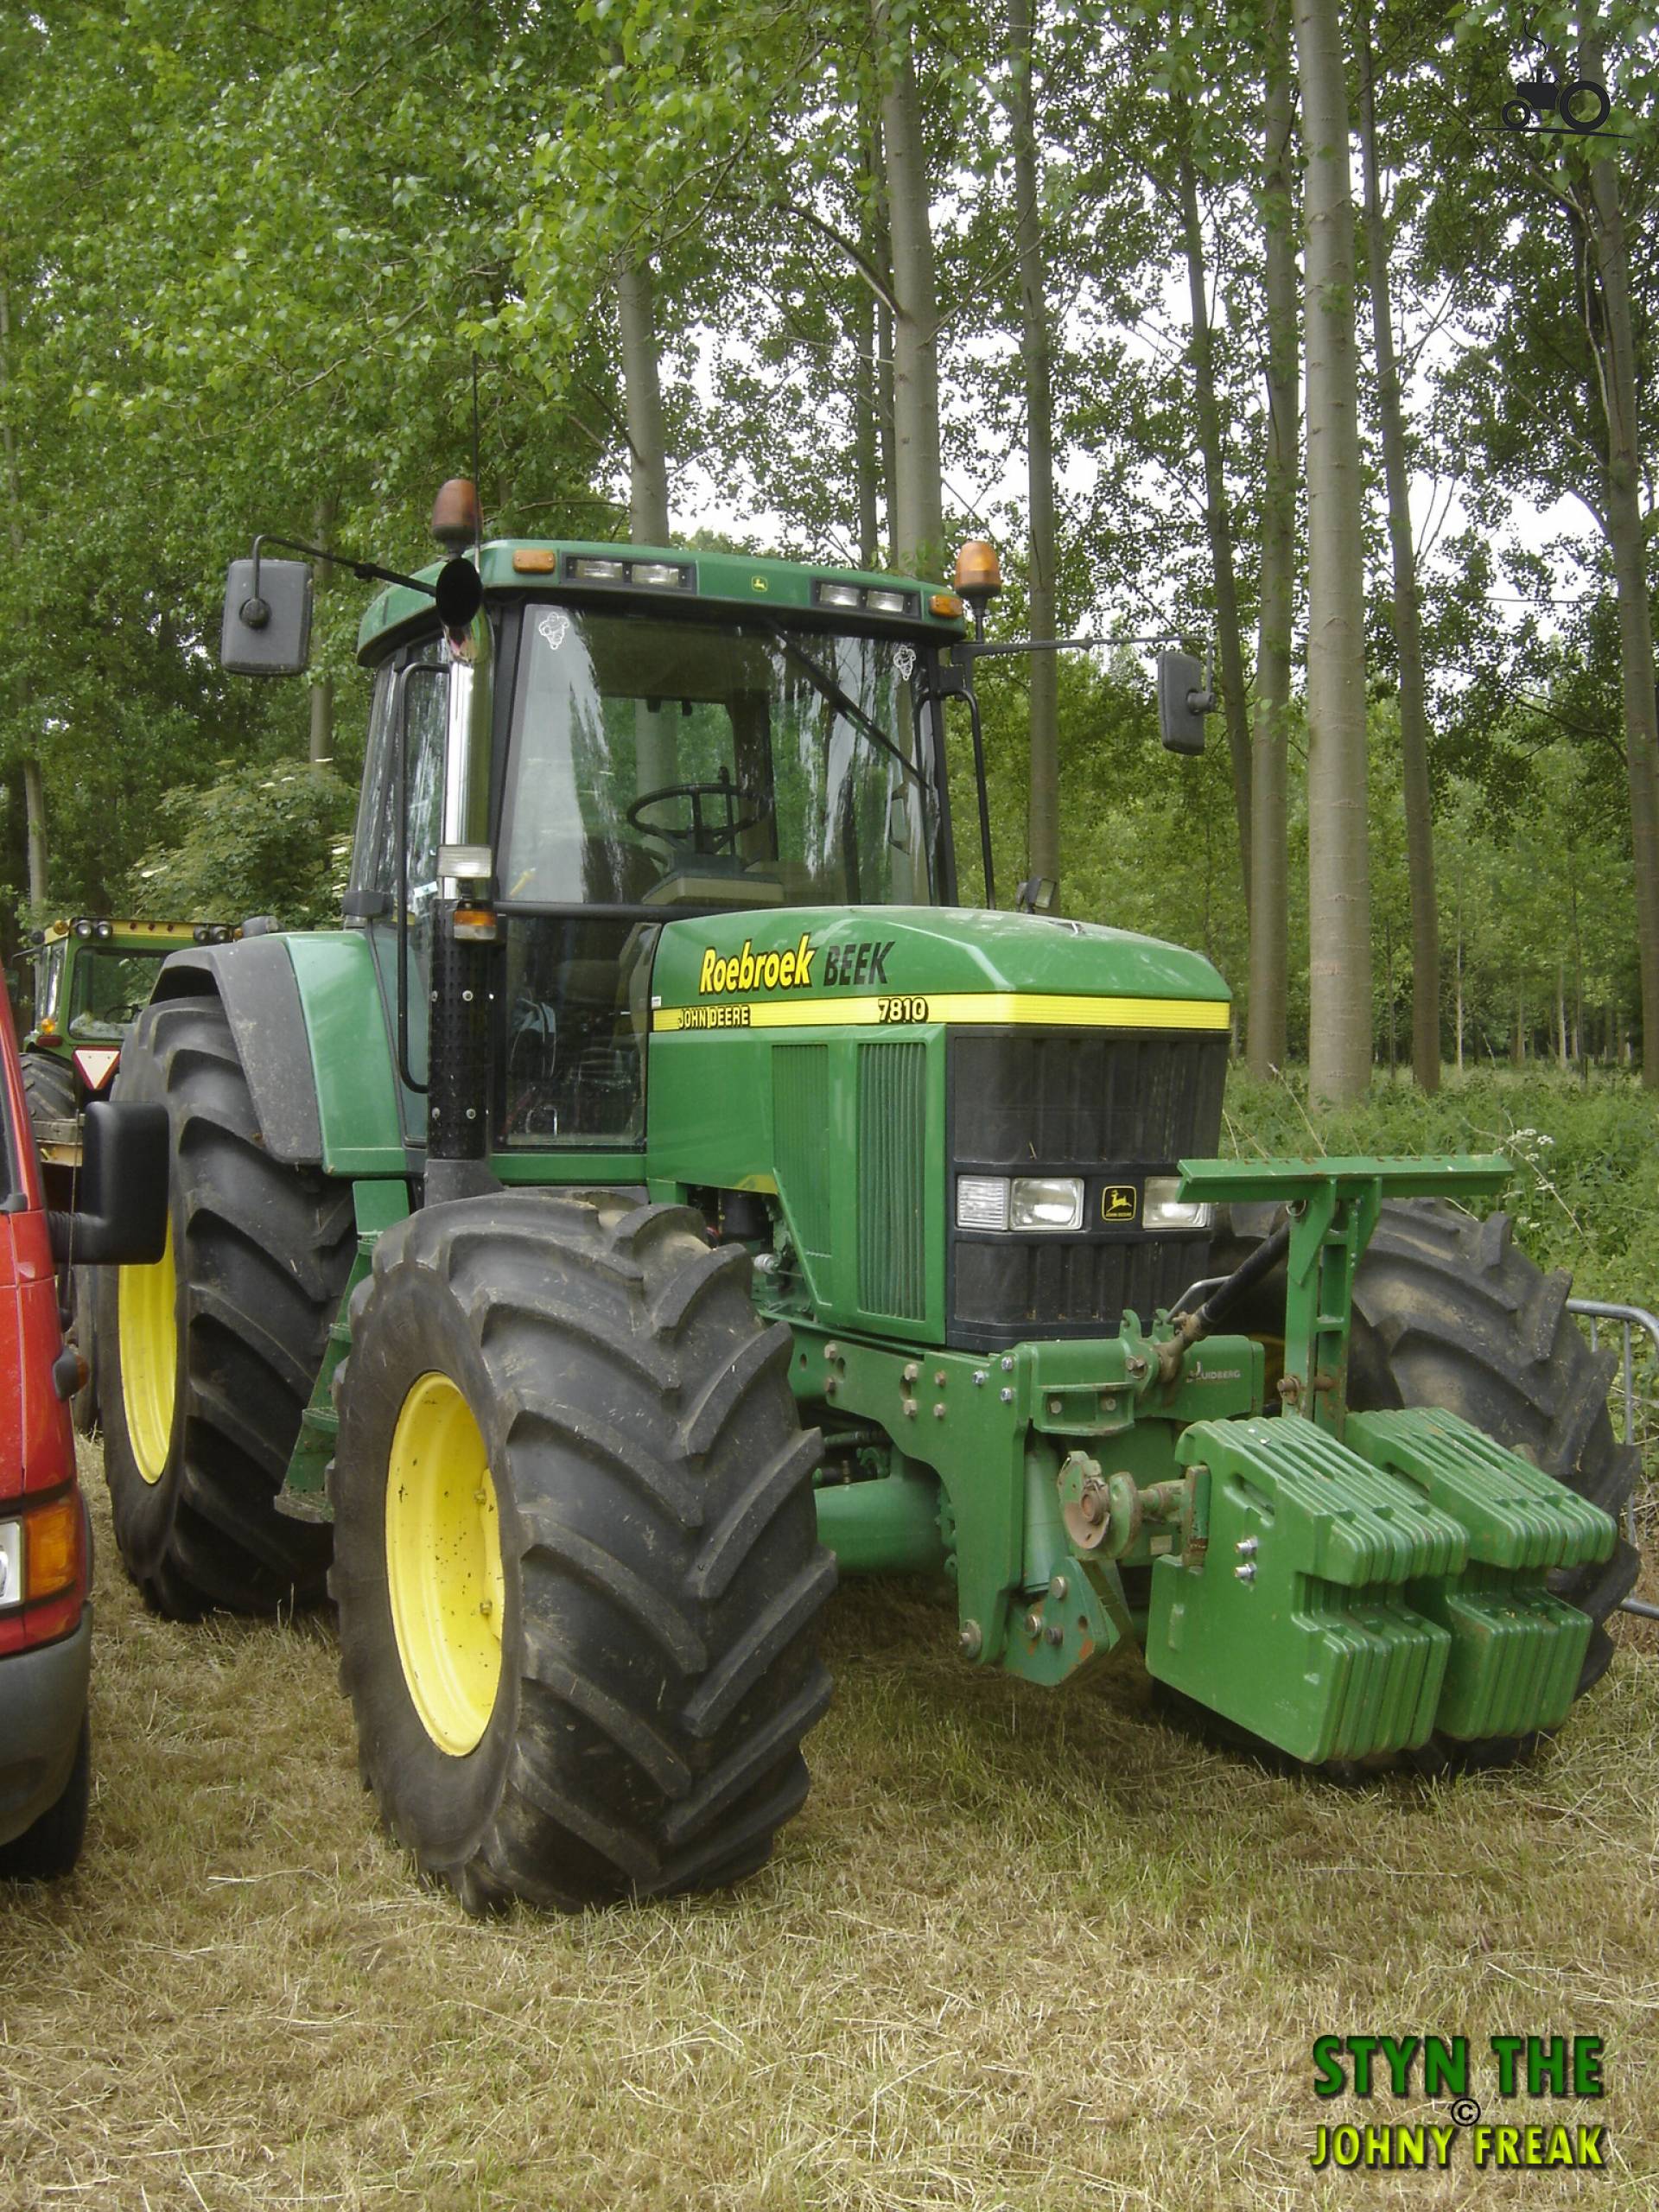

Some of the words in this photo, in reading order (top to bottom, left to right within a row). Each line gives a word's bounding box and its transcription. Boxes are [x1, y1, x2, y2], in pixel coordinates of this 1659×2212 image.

[699, 932, 818, 995] Roebroek
[823, 941, 895, 986] BEEK
[678, 1007, 707, 1028] JOHN
[709, 1005, 750, 1027] DEERE
[878, 997, 929, 1024] 7810
